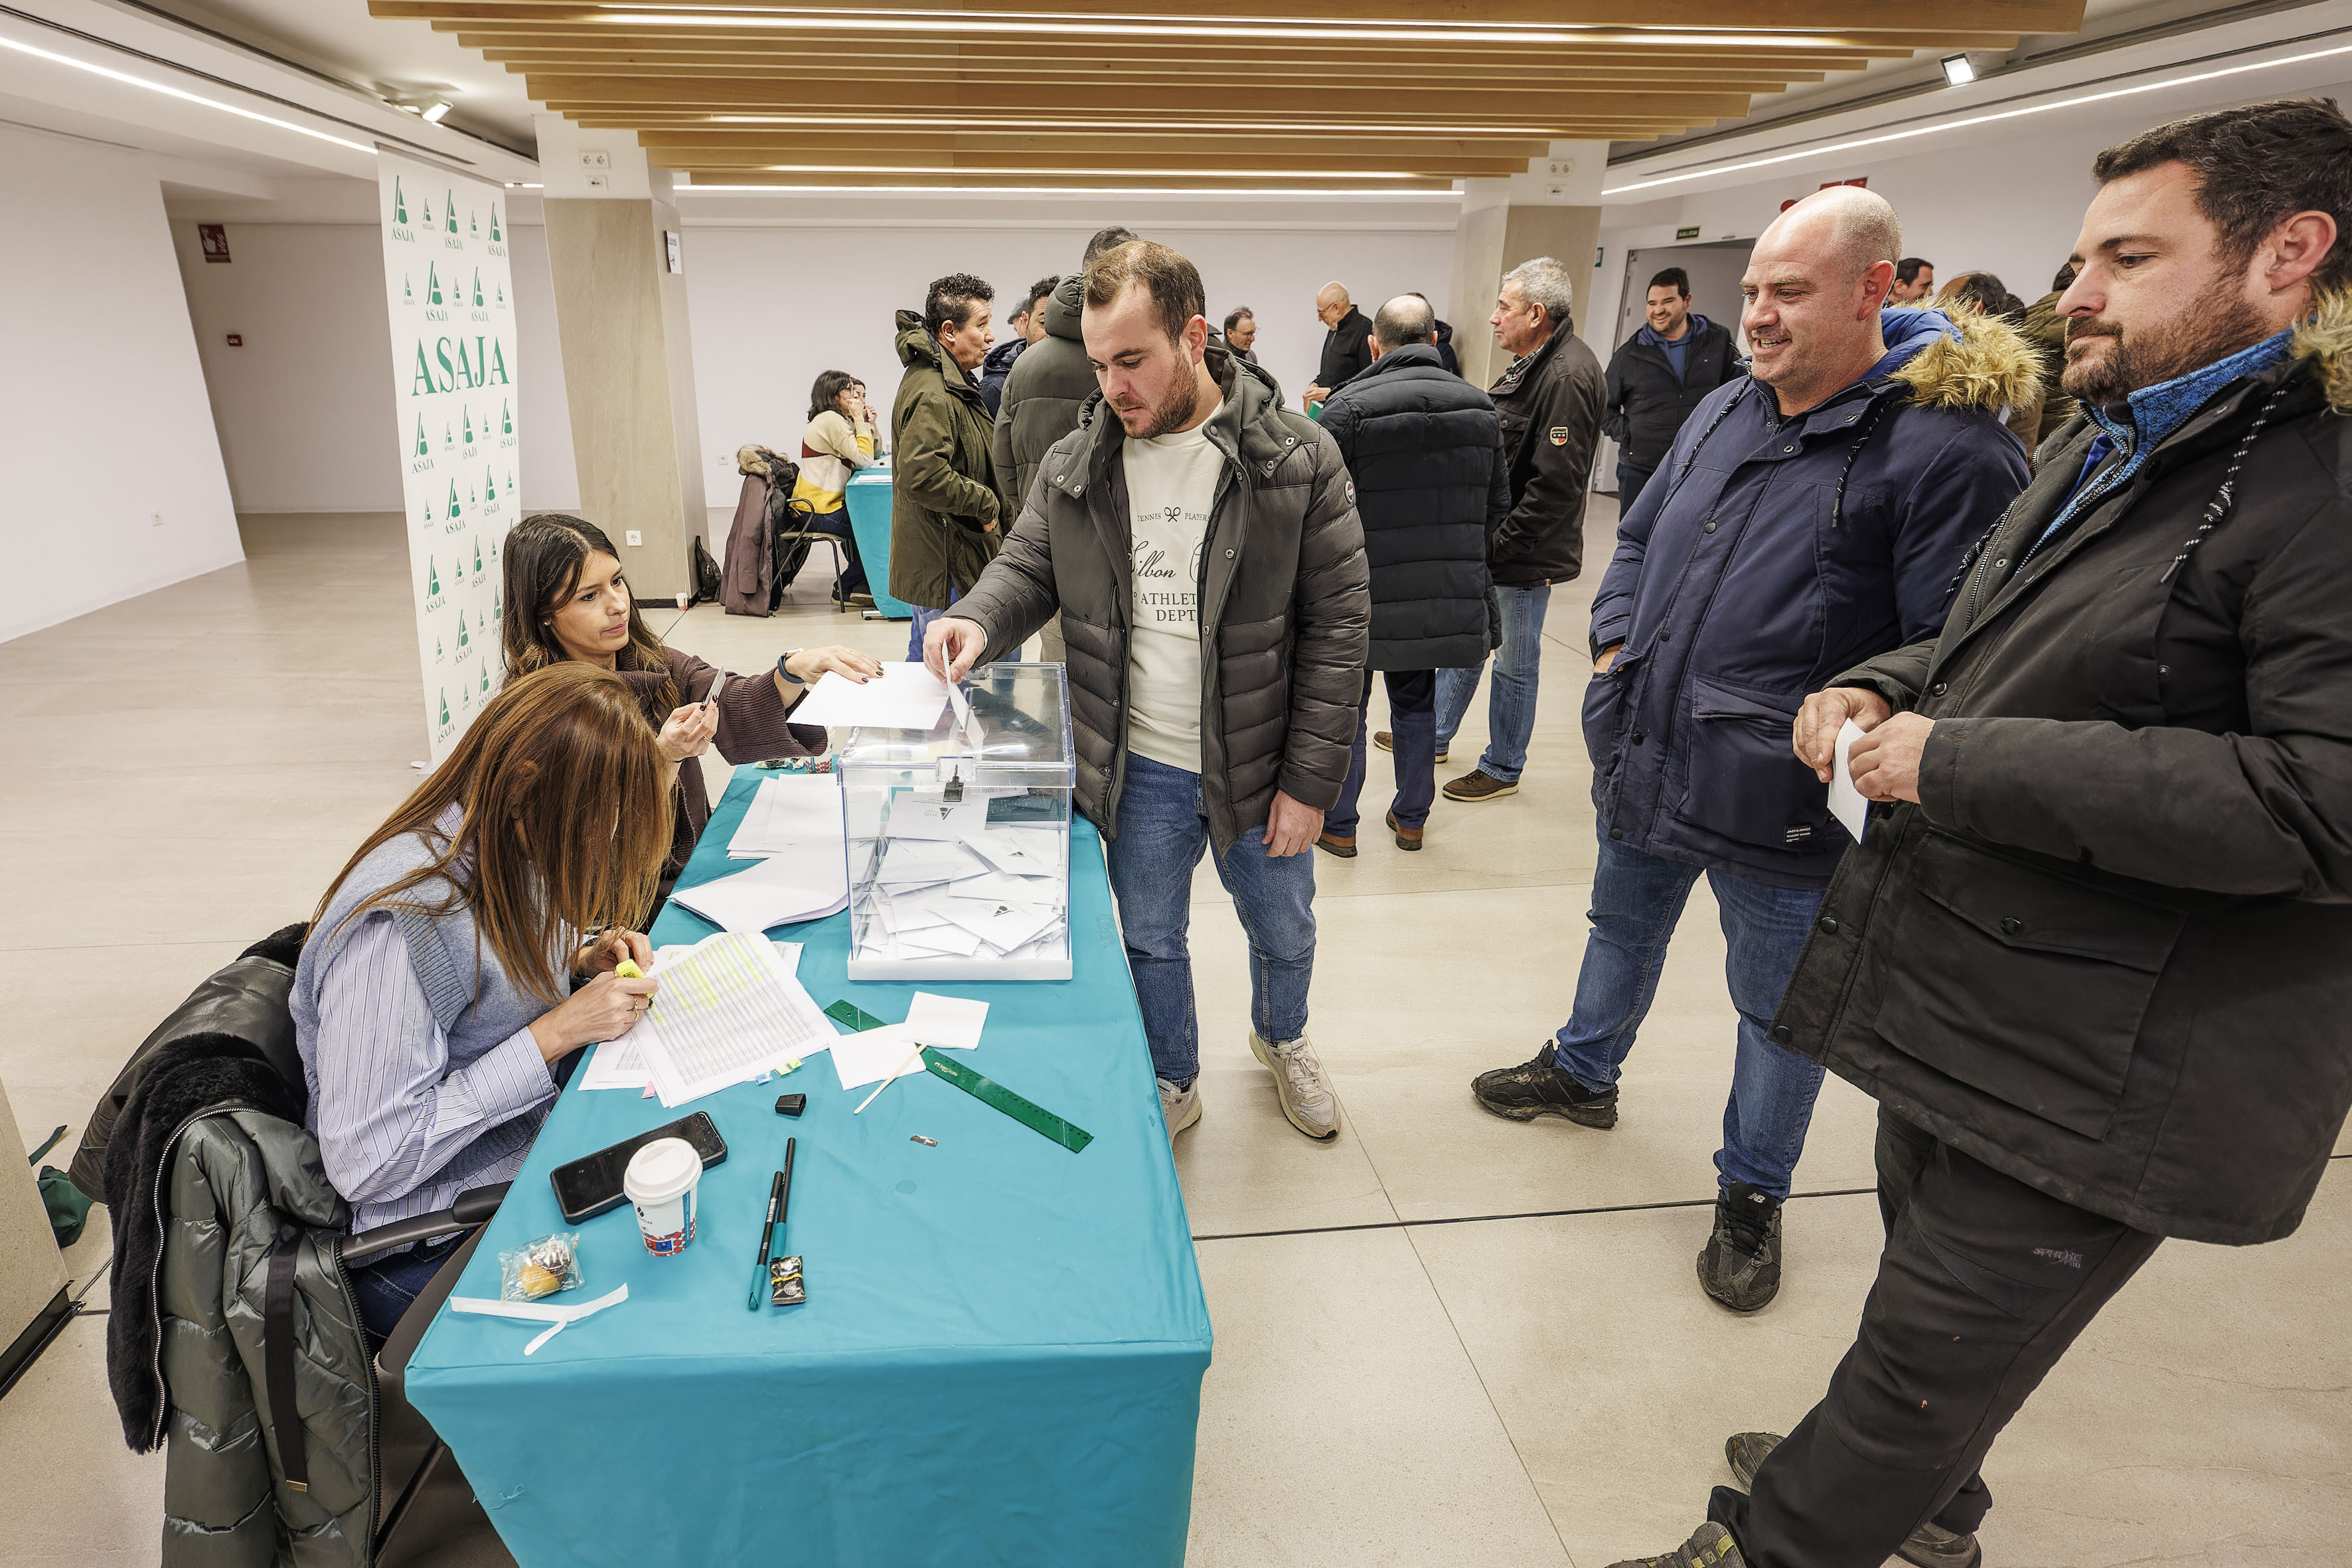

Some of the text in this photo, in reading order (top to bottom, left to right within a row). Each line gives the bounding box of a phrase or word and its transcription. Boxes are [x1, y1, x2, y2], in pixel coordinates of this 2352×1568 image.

[391, 227, 415, 243] ASAJA
[444, 236, 463, 250] ASAJA
[487, 244, 507, 258] ASAJA
[425, 308, 449, 322] ASAJA
[471, 310, 489, 322] ASAJA
[411, 336, 510, 396] ASAJA
[499, 436, 517, 449] ASAJA
[462, 445, 478, 461] ASAJA
[412, 457, 435, 474] ASAJA
[483, 502, 501, 518] ASAJA
[1137, 512, 1162, 522] TENNIS
[445, 519, 466, 536] ASAJA
[471, 572, 487, 589] ASAJA
[425, 595, 446, 615] ASAJA
[454, 645, 473, 666] ASAJA
[437, 722, 455, 746] ASAJA
